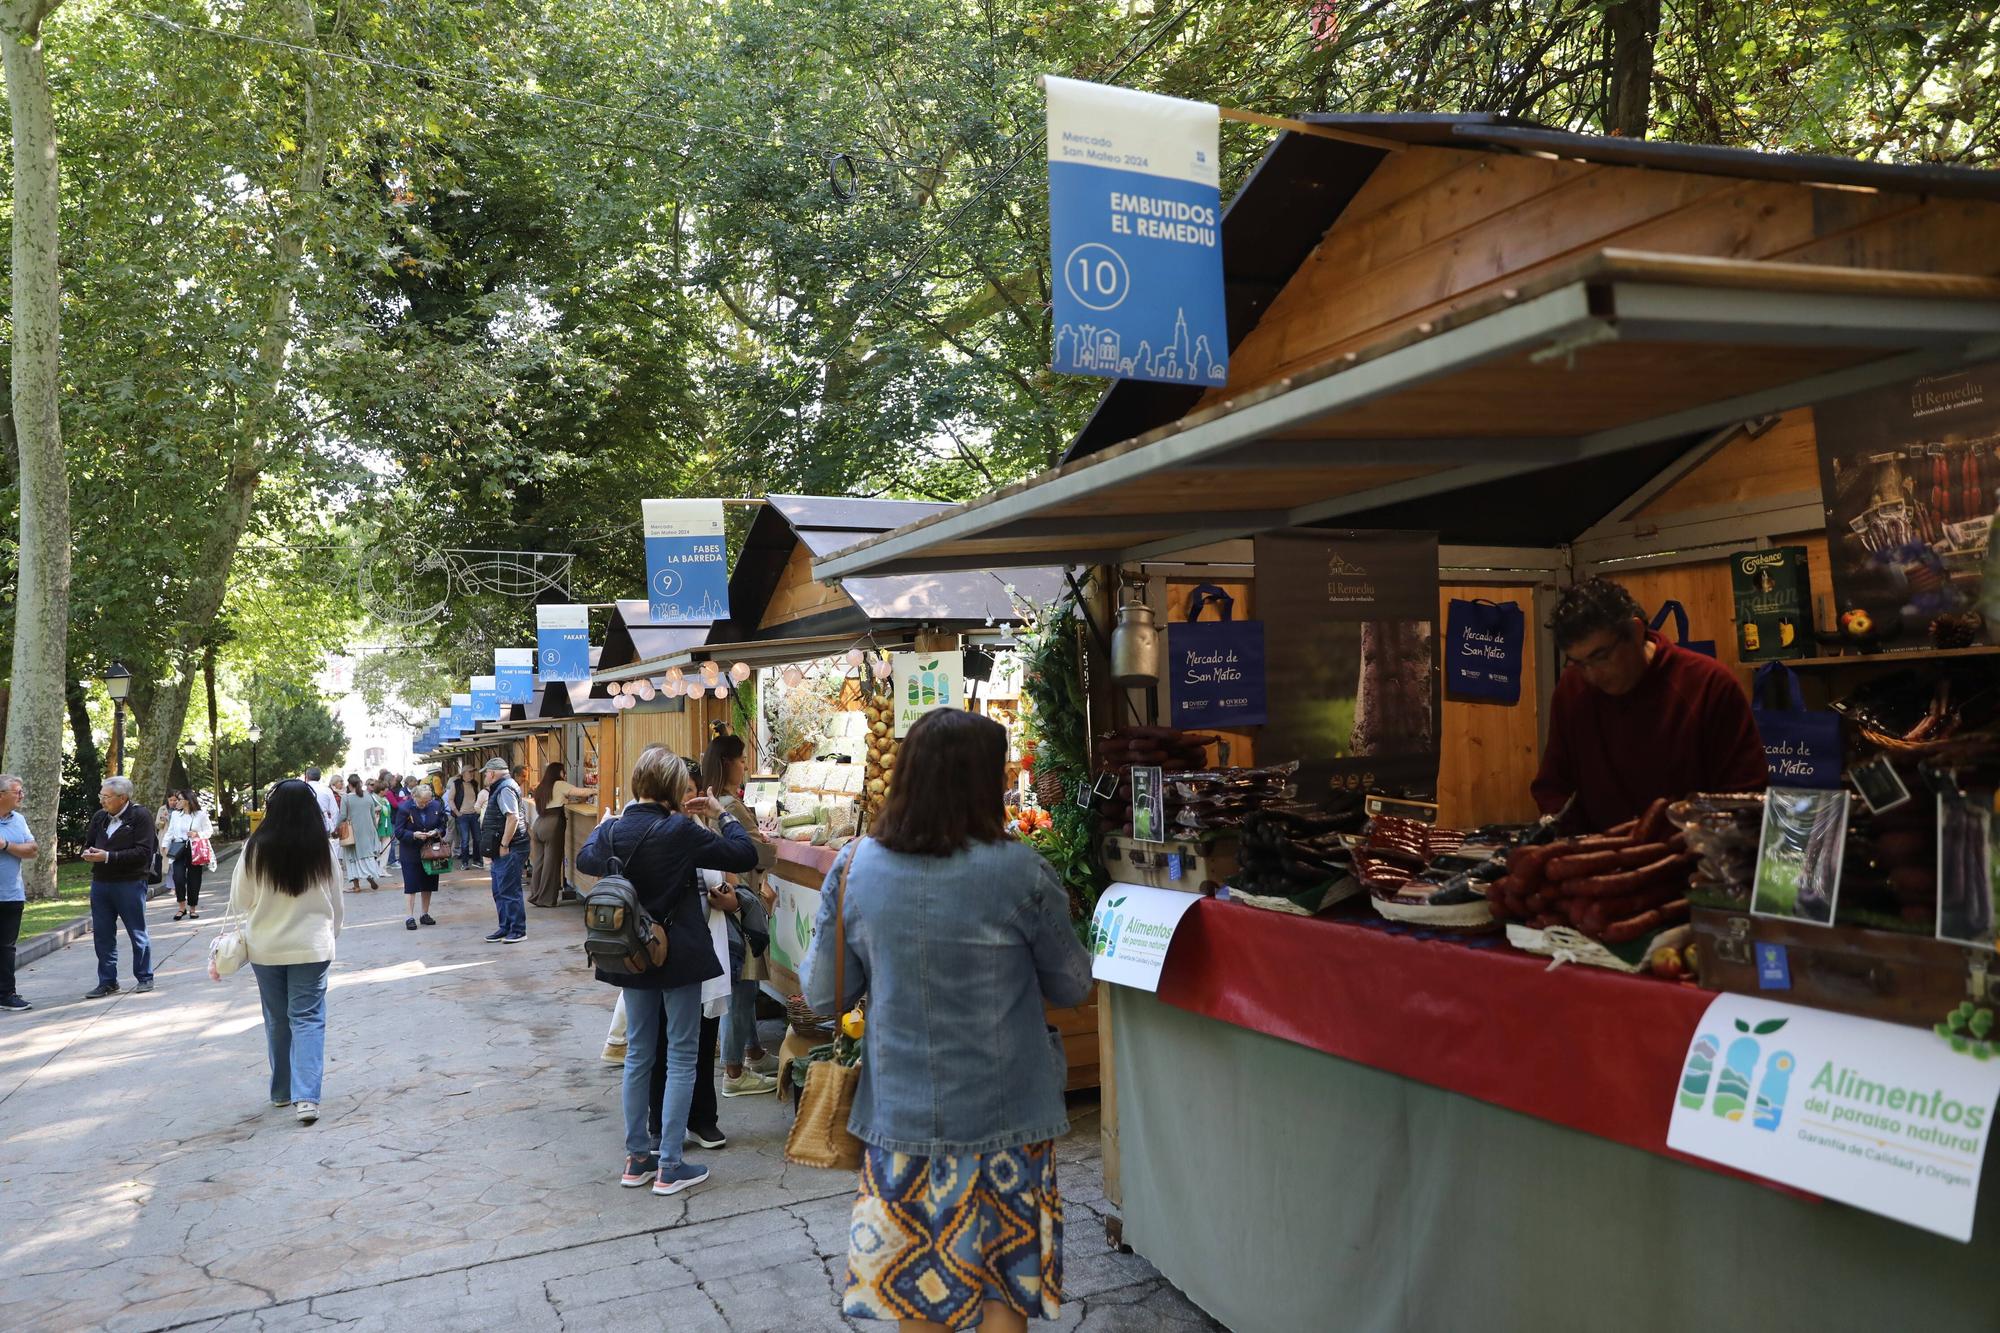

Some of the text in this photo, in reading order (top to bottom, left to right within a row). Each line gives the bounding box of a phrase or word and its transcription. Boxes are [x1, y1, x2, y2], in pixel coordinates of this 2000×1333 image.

[1062, 131, 1112, 148] Mercado
[1062, 145, 1149, 168] San Mateo 2024
[1110, 191, 1215, 226] EMBUTIDOS
[1111, 213, 1216, 248] EL REMEDIU
[1078, 258, 1117, 295] 10
[693, 545, 720, 553] FABES
[668, 554, 723, 563] LA BARREDA
[663, 575, 672, 590] 9
[1462, 626, 1505, 644] Mercado de
[547, 652, 555, 662] 8
[1186, 649, 1239, 667] Mercado de
[1461, 643, 1506, 660] San Mateo
[1184, 666, 1242, 684] San Mateo
[1762, 740, 1811, 756] cado de
[1779, 758, 1815, 777] Mateo
[1125, 916, 1173, 939] Alimentos
[1810, 1060, 1986, 1130] Alimentos
[1804, 1096, 1830, 1115] del
[1905, 1123, 1979, 1155] natural
[1848, 1144, 1864, 1156] de
[1864, 1147, 1914, 1172] Calidad
[1914, 1164, 1924, 1176] y
[1924, 1164, 1972, 1188] Origen
